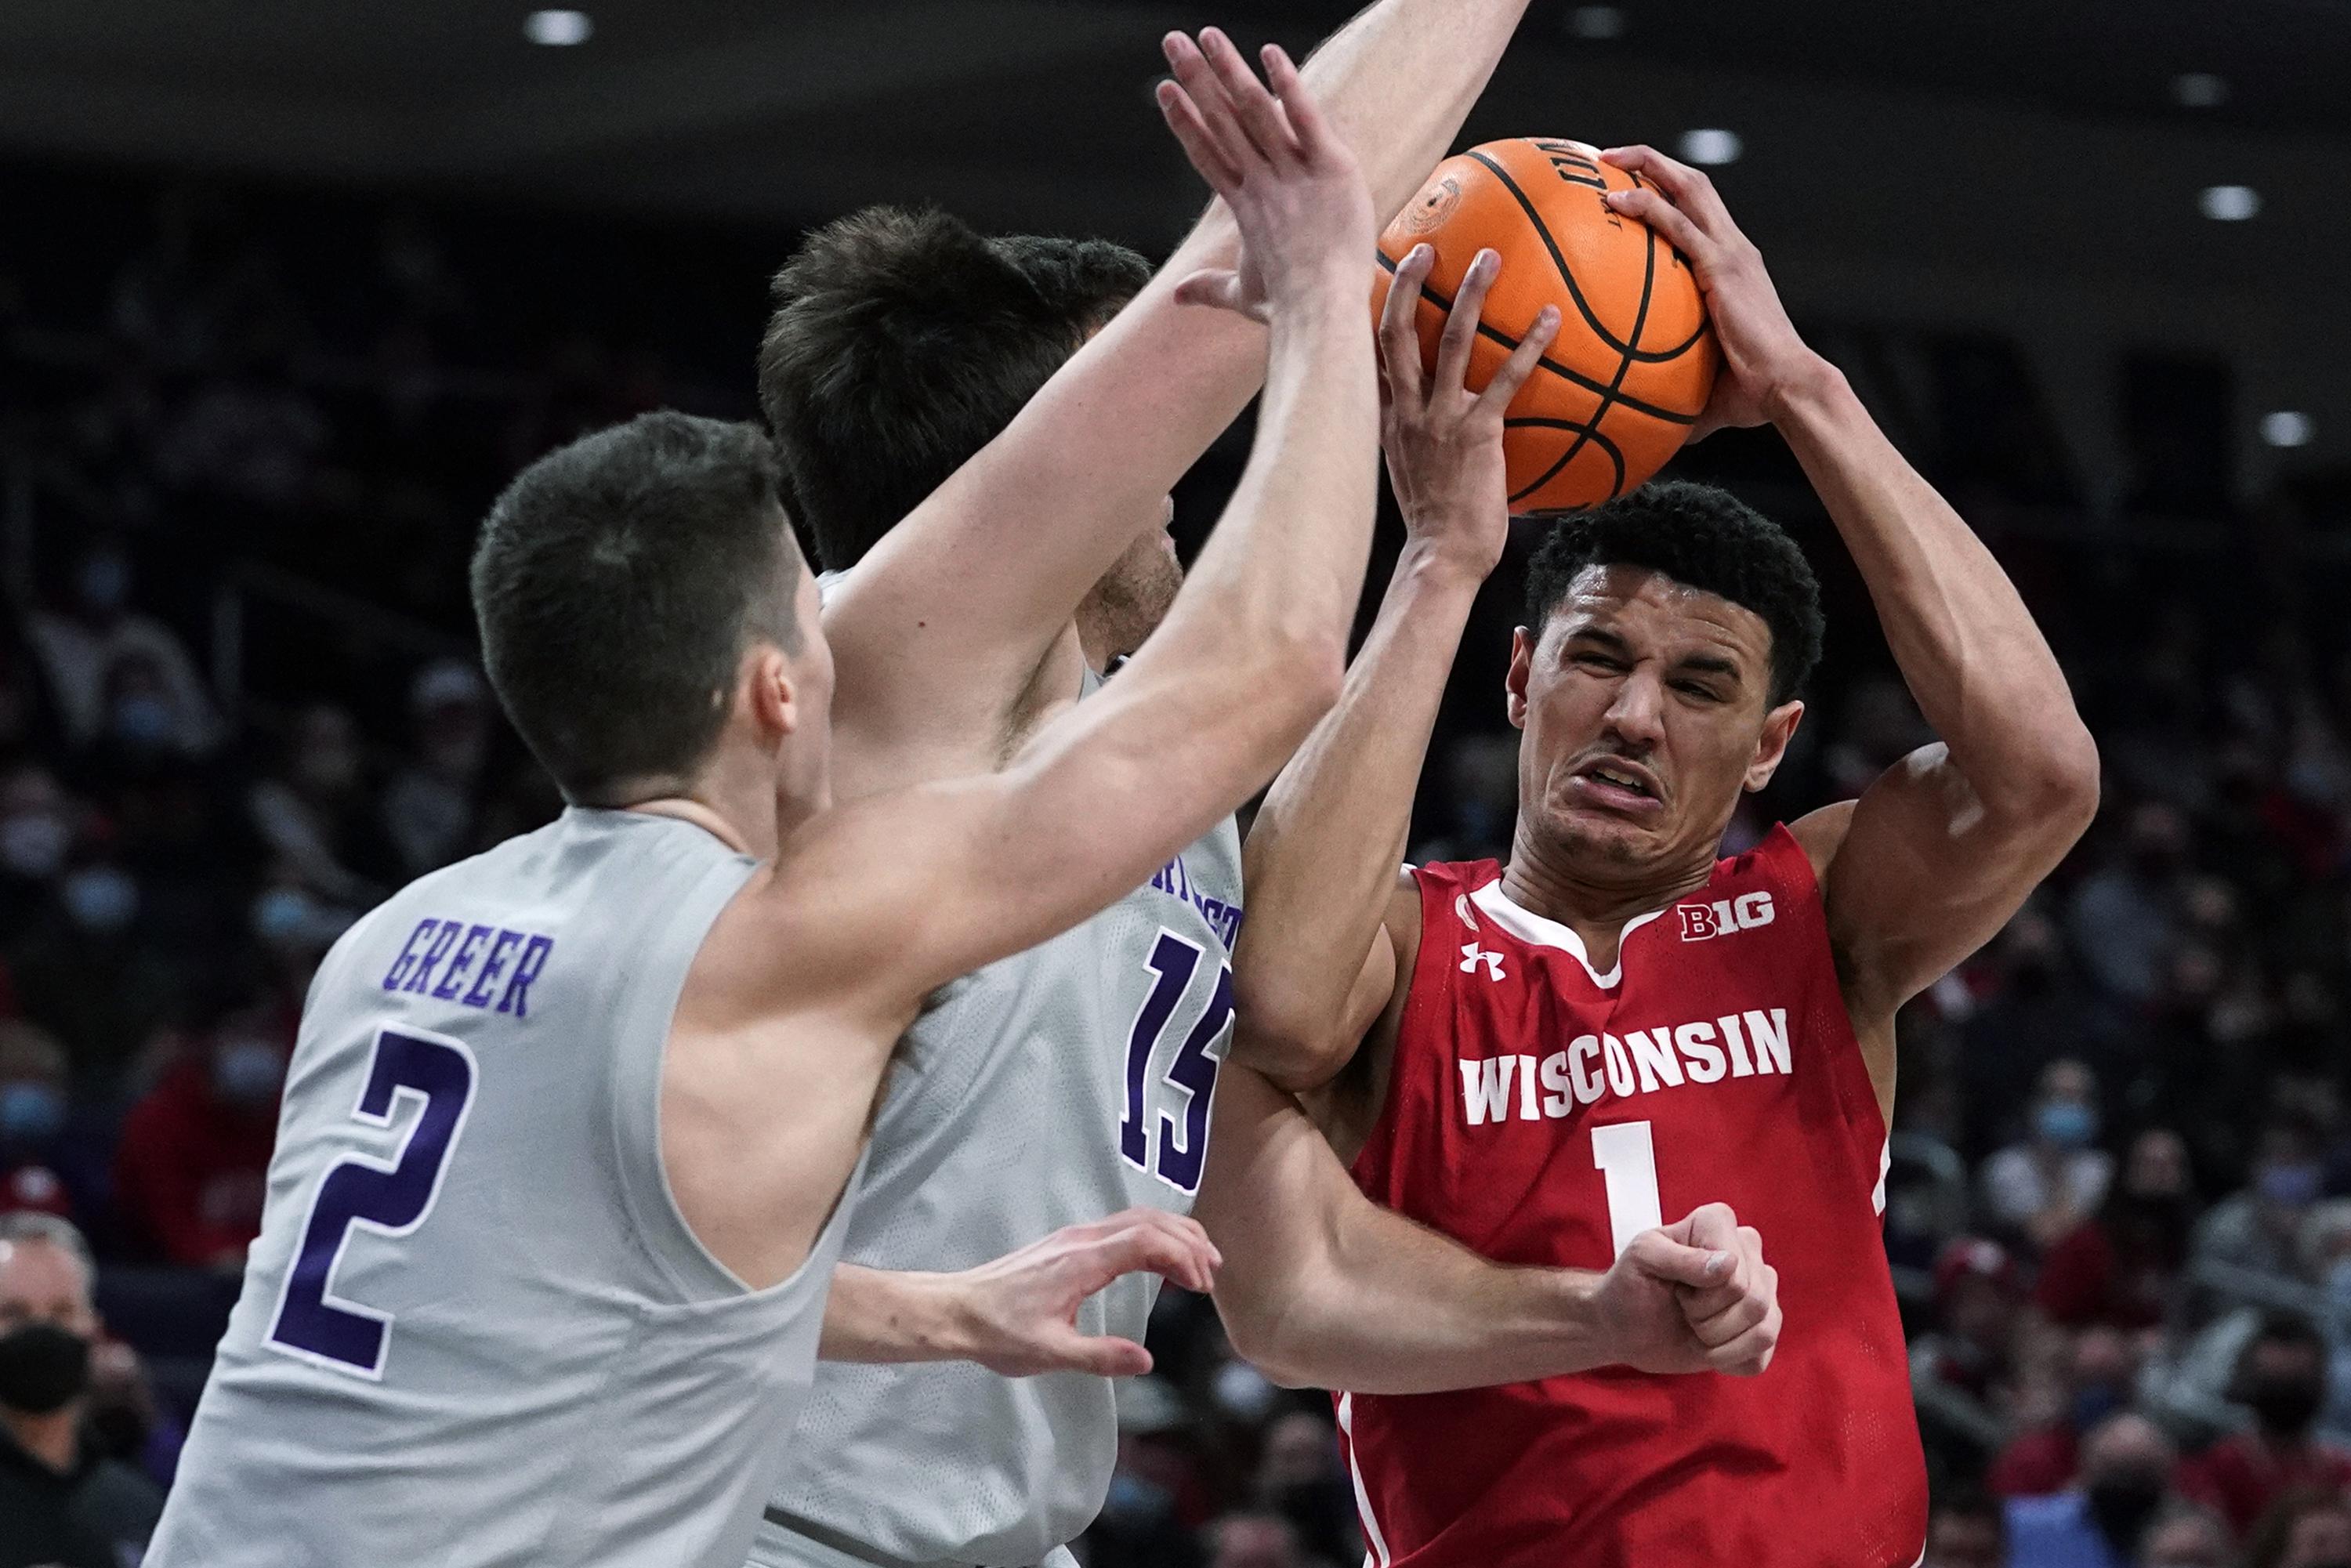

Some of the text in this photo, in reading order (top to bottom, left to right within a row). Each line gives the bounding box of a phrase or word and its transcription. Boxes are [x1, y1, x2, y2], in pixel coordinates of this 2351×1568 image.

[382, 918, 554, 1017] GREER
[1121, 925, 1236, 1197] 15
[1459, 1008, 1794, 1126] WISCONSIN
[262, 1020, 479, 1382] 2
[1591, 1121, 1663, 1263] 1
